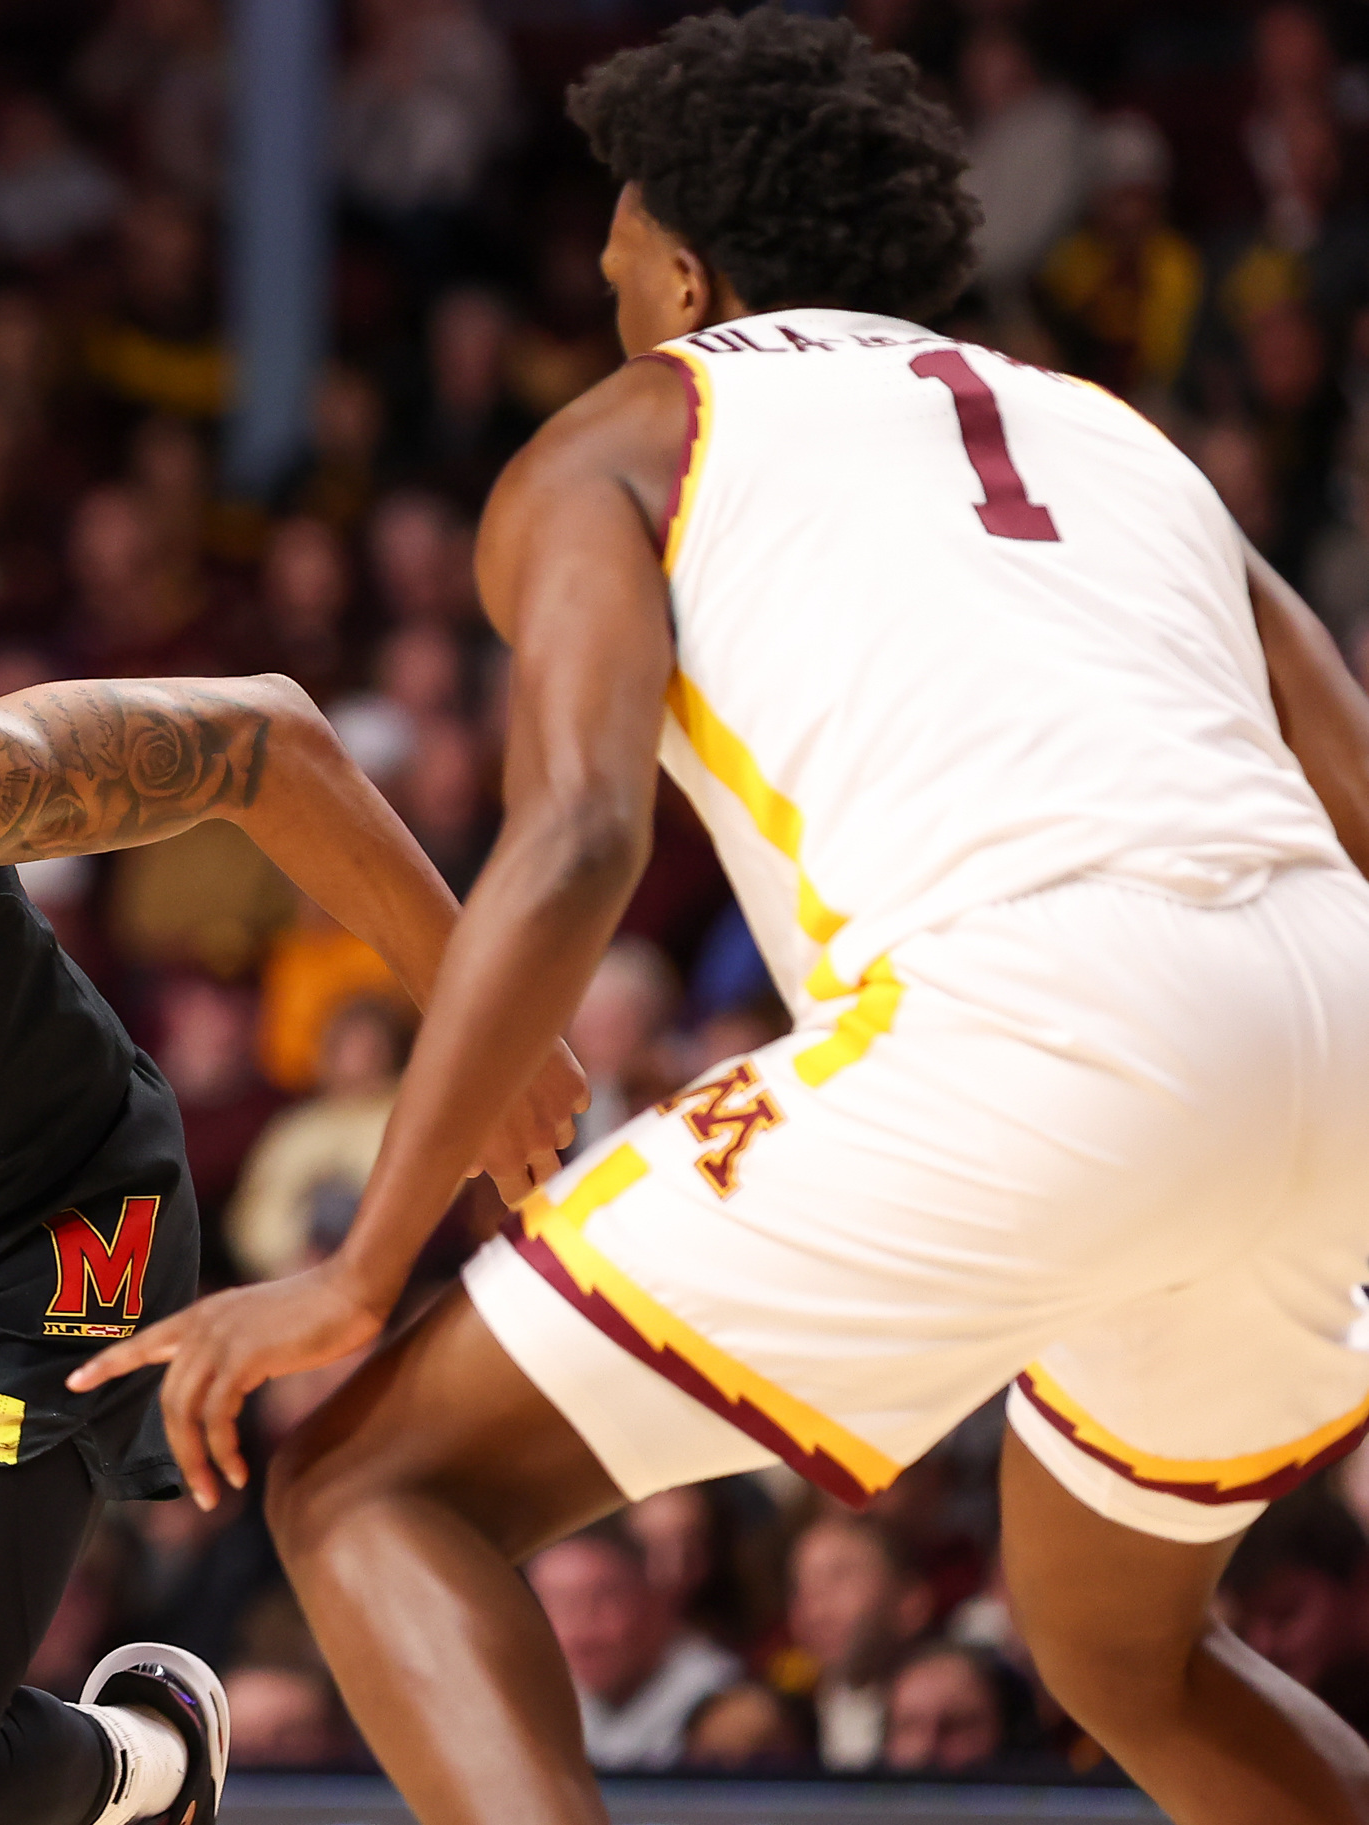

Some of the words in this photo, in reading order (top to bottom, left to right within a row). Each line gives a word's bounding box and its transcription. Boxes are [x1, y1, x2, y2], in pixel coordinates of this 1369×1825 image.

[909, 350, 1062, 542] 1
[655, 1060, 785, 1200] M
[41, 1195, 161, 1319] M
